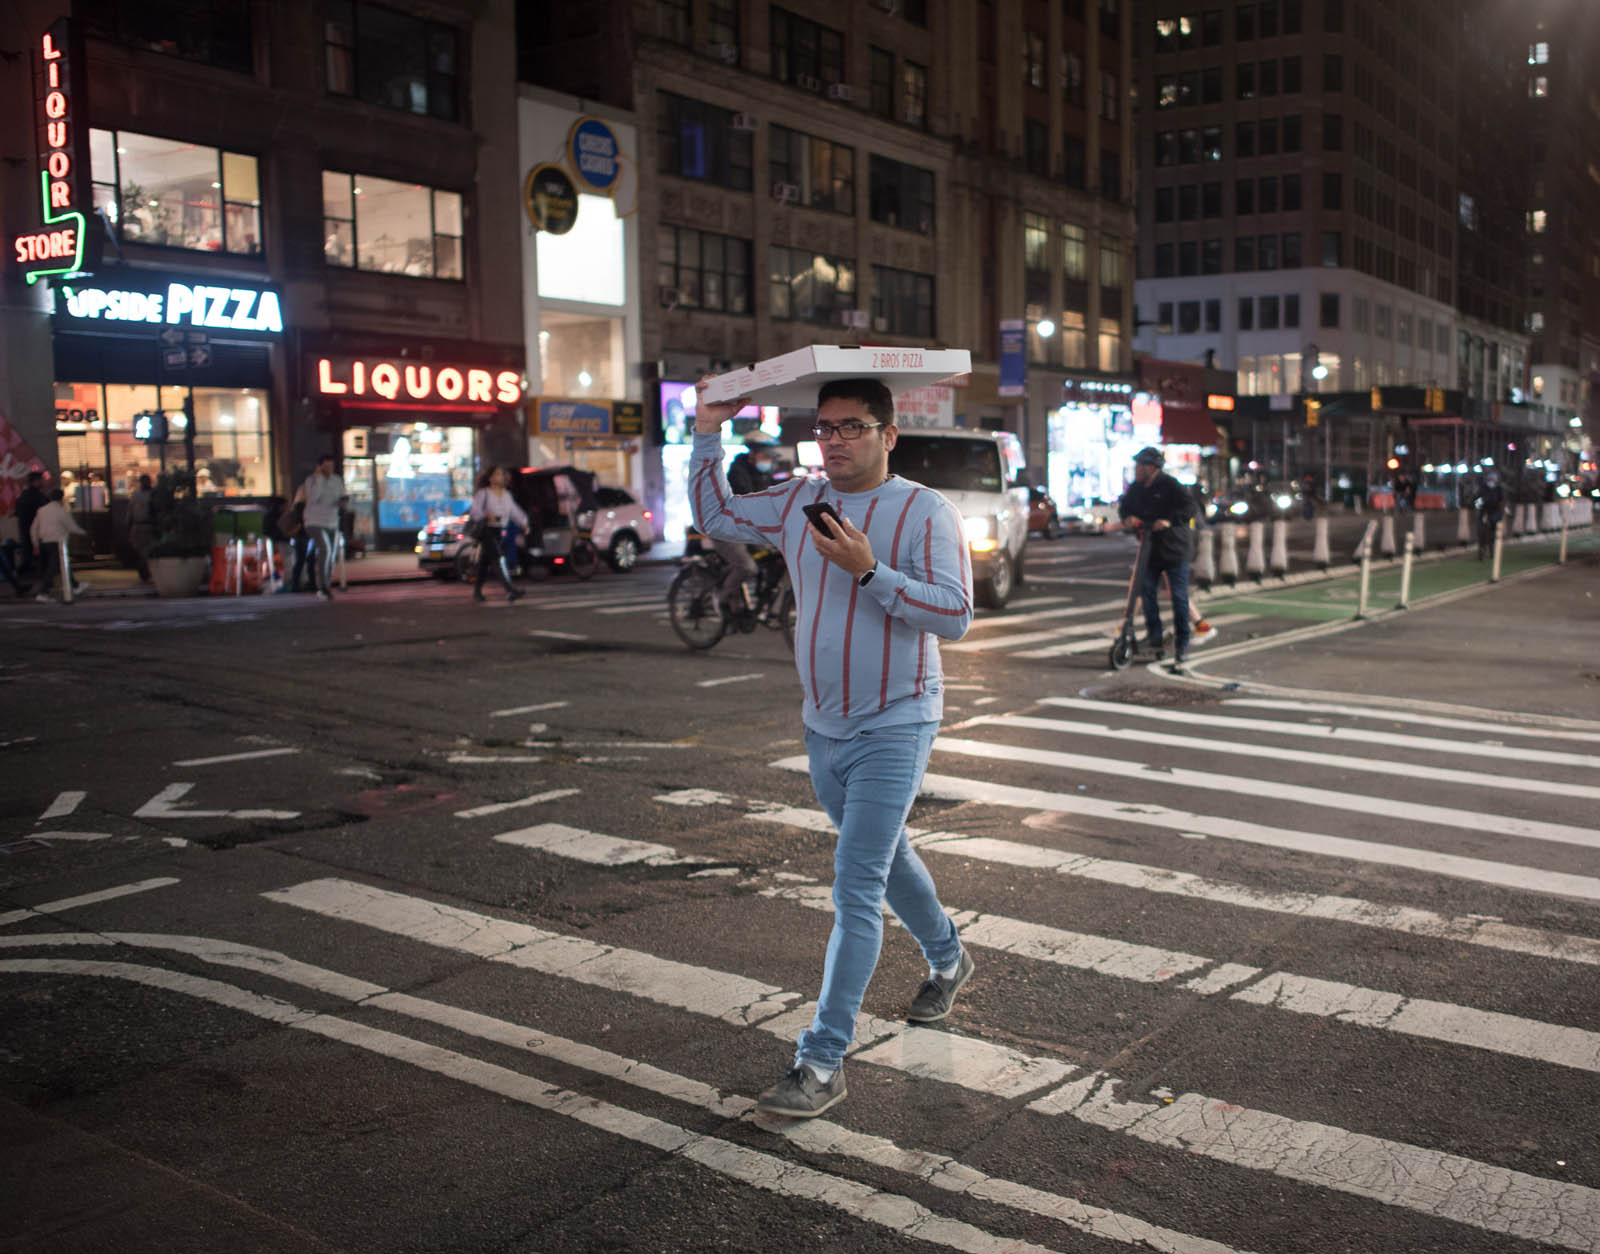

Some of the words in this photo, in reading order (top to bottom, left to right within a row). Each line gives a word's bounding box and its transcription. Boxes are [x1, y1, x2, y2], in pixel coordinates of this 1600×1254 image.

[42, 33, 70, 208] LIQUOR
[15, 229, 76, 263] STORE
[62, 286, 165, 323] UPSIDE
[166, 282, 283, 332] PIZZA
[872, 353, 878, 368] 2
[880, 353, 899, 368] BROS
[902, 353, 923, 368] PIZZA
[318, 358, 521, 404] LIQUORS
[55, 408, 99, 422] 598
